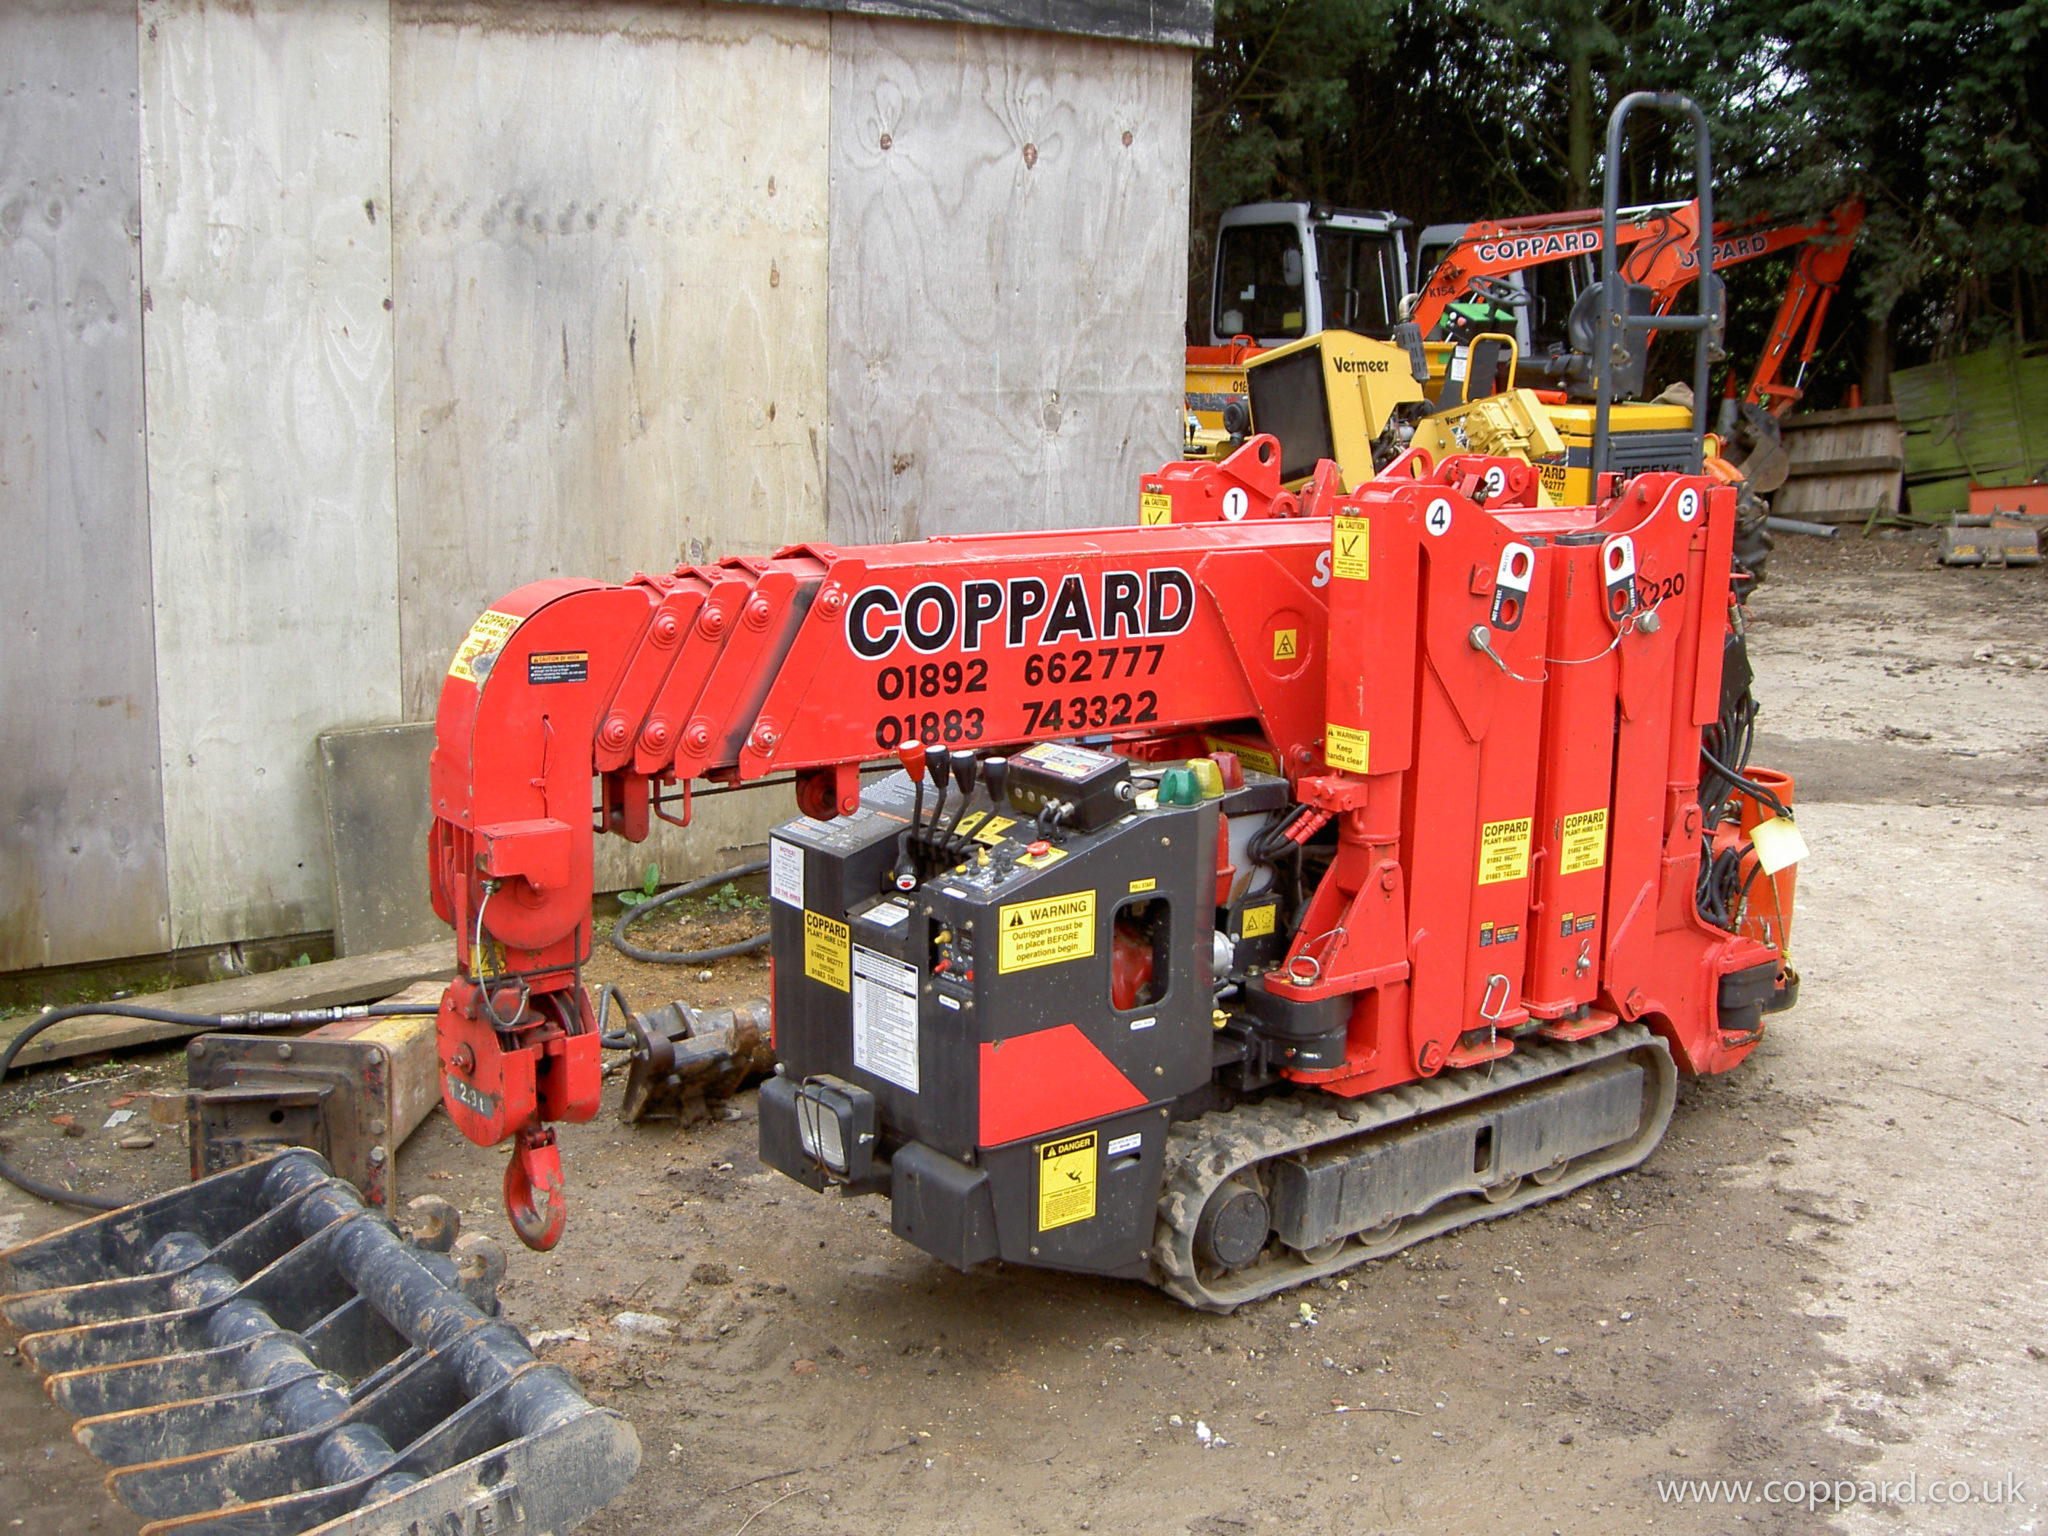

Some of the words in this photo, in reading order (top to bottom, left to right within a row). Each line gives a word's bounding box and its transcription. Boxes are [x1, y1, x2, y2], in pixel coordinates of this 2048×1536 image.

[1478, 230, 1599, 262] COPPARD
[1681, 236, 1768, 268] OPARD
[1429, 286, 1455, 299] K154
[1333, 357, 1389, 373] Vermeer
[1488, 472, 1500, 491] 2
[1533, 464, 1566, 480] PARD
[1231, 493, 1239, 515] 1
[1682, 494, 1694, 516] 3
[1345, 521, 1365, 531] CAUTION
[1431, 505, 1446, 529] 4
[845, 567, 1196, 661] COPPARD
[877, 658, 988, 701] 01892
[1024, 644, 1165, 686] 662777
[875, 707, 985, 749] 01883
[1022, 690, 1158, 735] 743322
[1336, 731, 1364, 742] WARNING
[1336, 743, 1353, 754] Keep
[1347, 757, 1363, 766] clear
[1484, 821, 1528, 837] COPPARD
[1565, 811, 1605, 829] COPPARD
[1484, 837, 1501, 846] PLANT
[1517, 833, 1528, 841] LTD
[1565, 828, 1581, 837] PLANT
[1030, 900, 1087, 921] WARNING
[806, 913, 847, 939] COPPARD
[1012, 927, 1052, 941] Outriggers
[1053, 923, 1072, 933] must
[1073, 920, 1083, 929] be
[807, 927, 823, 939] PLANT
[824, 934, 836, 945] HIRE
[837, 938, 847, 948] LTD
[1016, 942, 1023, 950] in
[1025, 938, 1045, 951] place
[1047, 932, 1079, 945] BEFORE
[1016, 948, 1056, 962] operations
[1057, 943, 1079, 954] begin
[1058, 1138, 1091, 1154] DANGER
